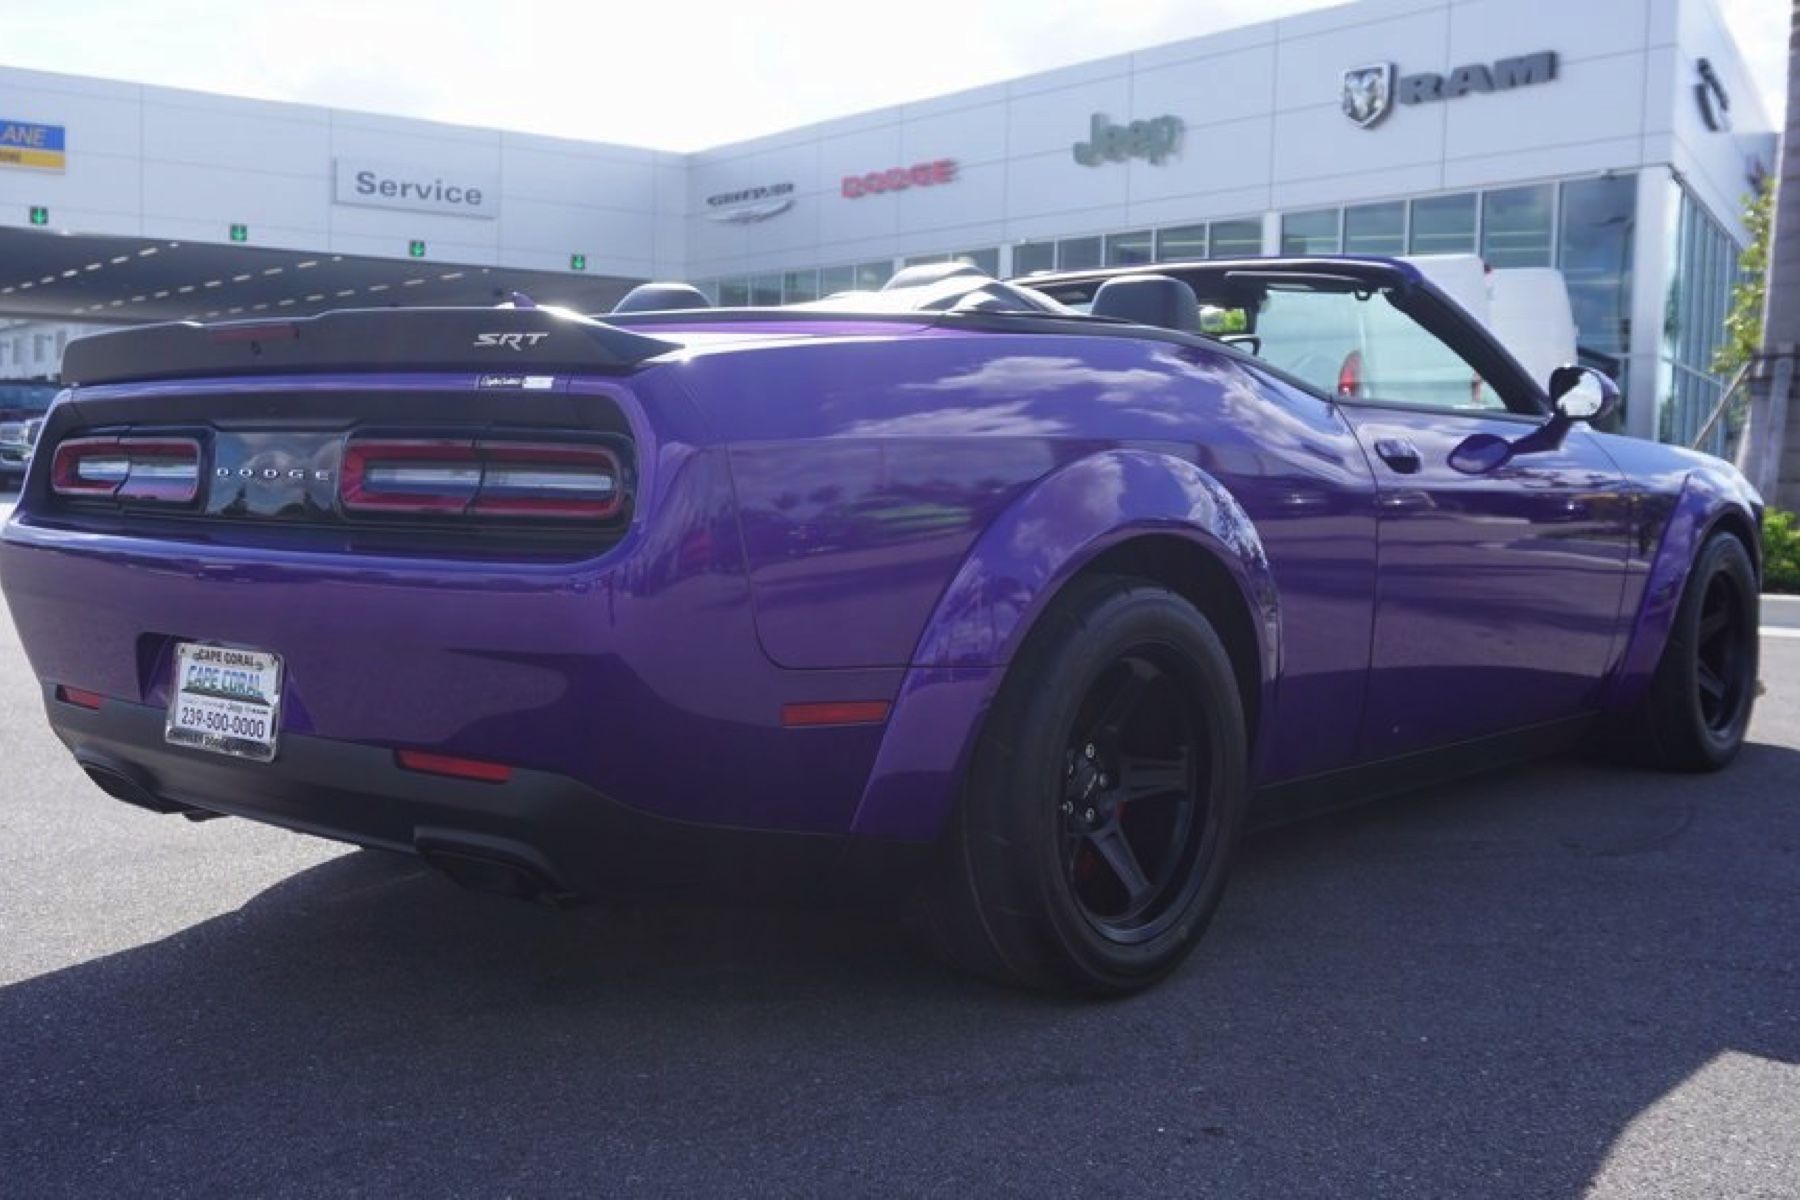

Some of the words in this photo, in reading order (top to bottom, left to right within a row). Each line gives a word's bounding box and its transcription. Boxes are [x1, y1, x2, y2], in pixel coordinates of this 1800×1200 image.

[1399, 50, 1559, 105] RAM
[0, 122, 48, 147] ANE
[1072, 112, 1186, 168] Jeep
[355, 170, 484, 206] Service
[840, 157, 958, 199] DODGE
[472, 331, 550, 352] SRT
[216, 466, 331, 482] DODGE
